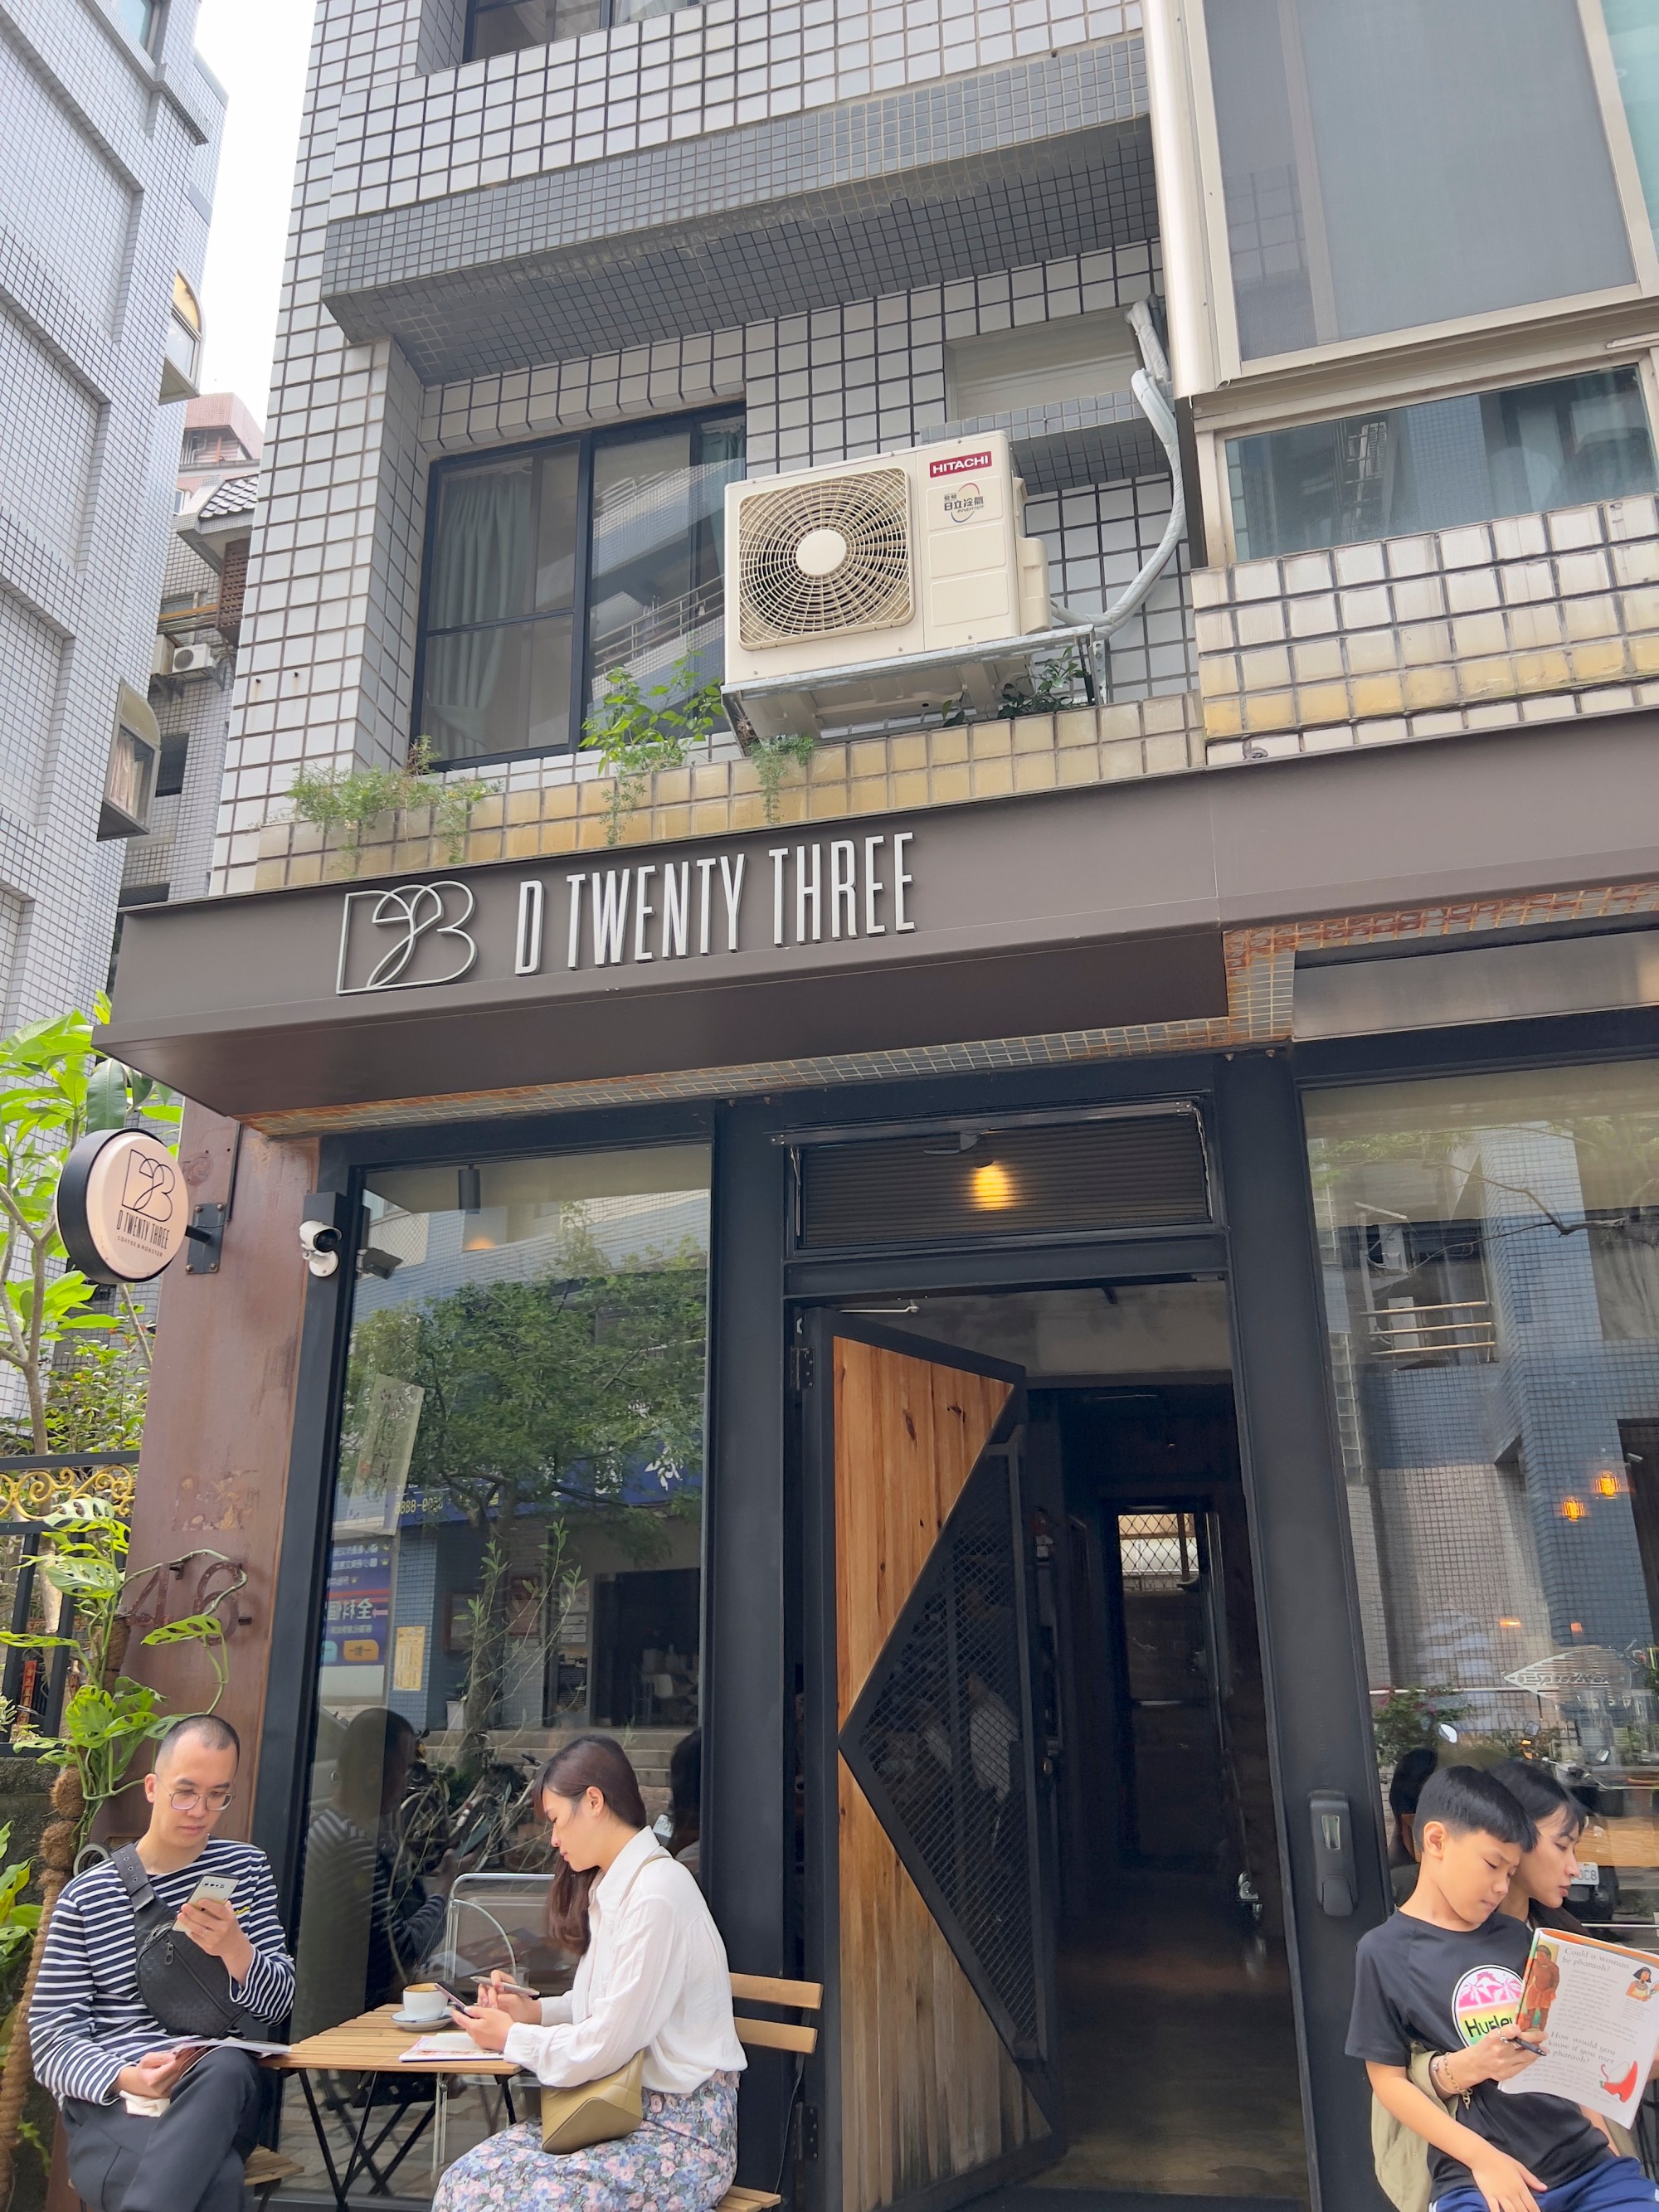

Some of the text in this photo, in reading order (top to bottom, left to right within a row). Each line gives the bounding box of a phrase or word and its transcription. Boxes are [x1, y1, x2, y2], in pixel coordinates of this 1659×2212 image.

[932, 455, 989, 474] HITACHI
[515, 831, 917, 976] D TWENTY THREE
[117, 1210, 170, 1249] D TWENTY THREE
[117, 1235, 136, 1247] COFFEE
[141, 1245, 163, 1257] ROASTER
[1562, 1956, 1611, 1971] be pharaoh?
[1564, 1947, 1588, 1957] Could
[1599, 1957, 1629, 1969] woman
[1549, 2039, 1569, 2049] know
[1580, 2049, 1595, 2057] you
[1598, 2054, 1614, 2064] met
[1550, 2031, 1616, 2055] How would you
[1553, 2050, 1590, 2063] pharaoh?
